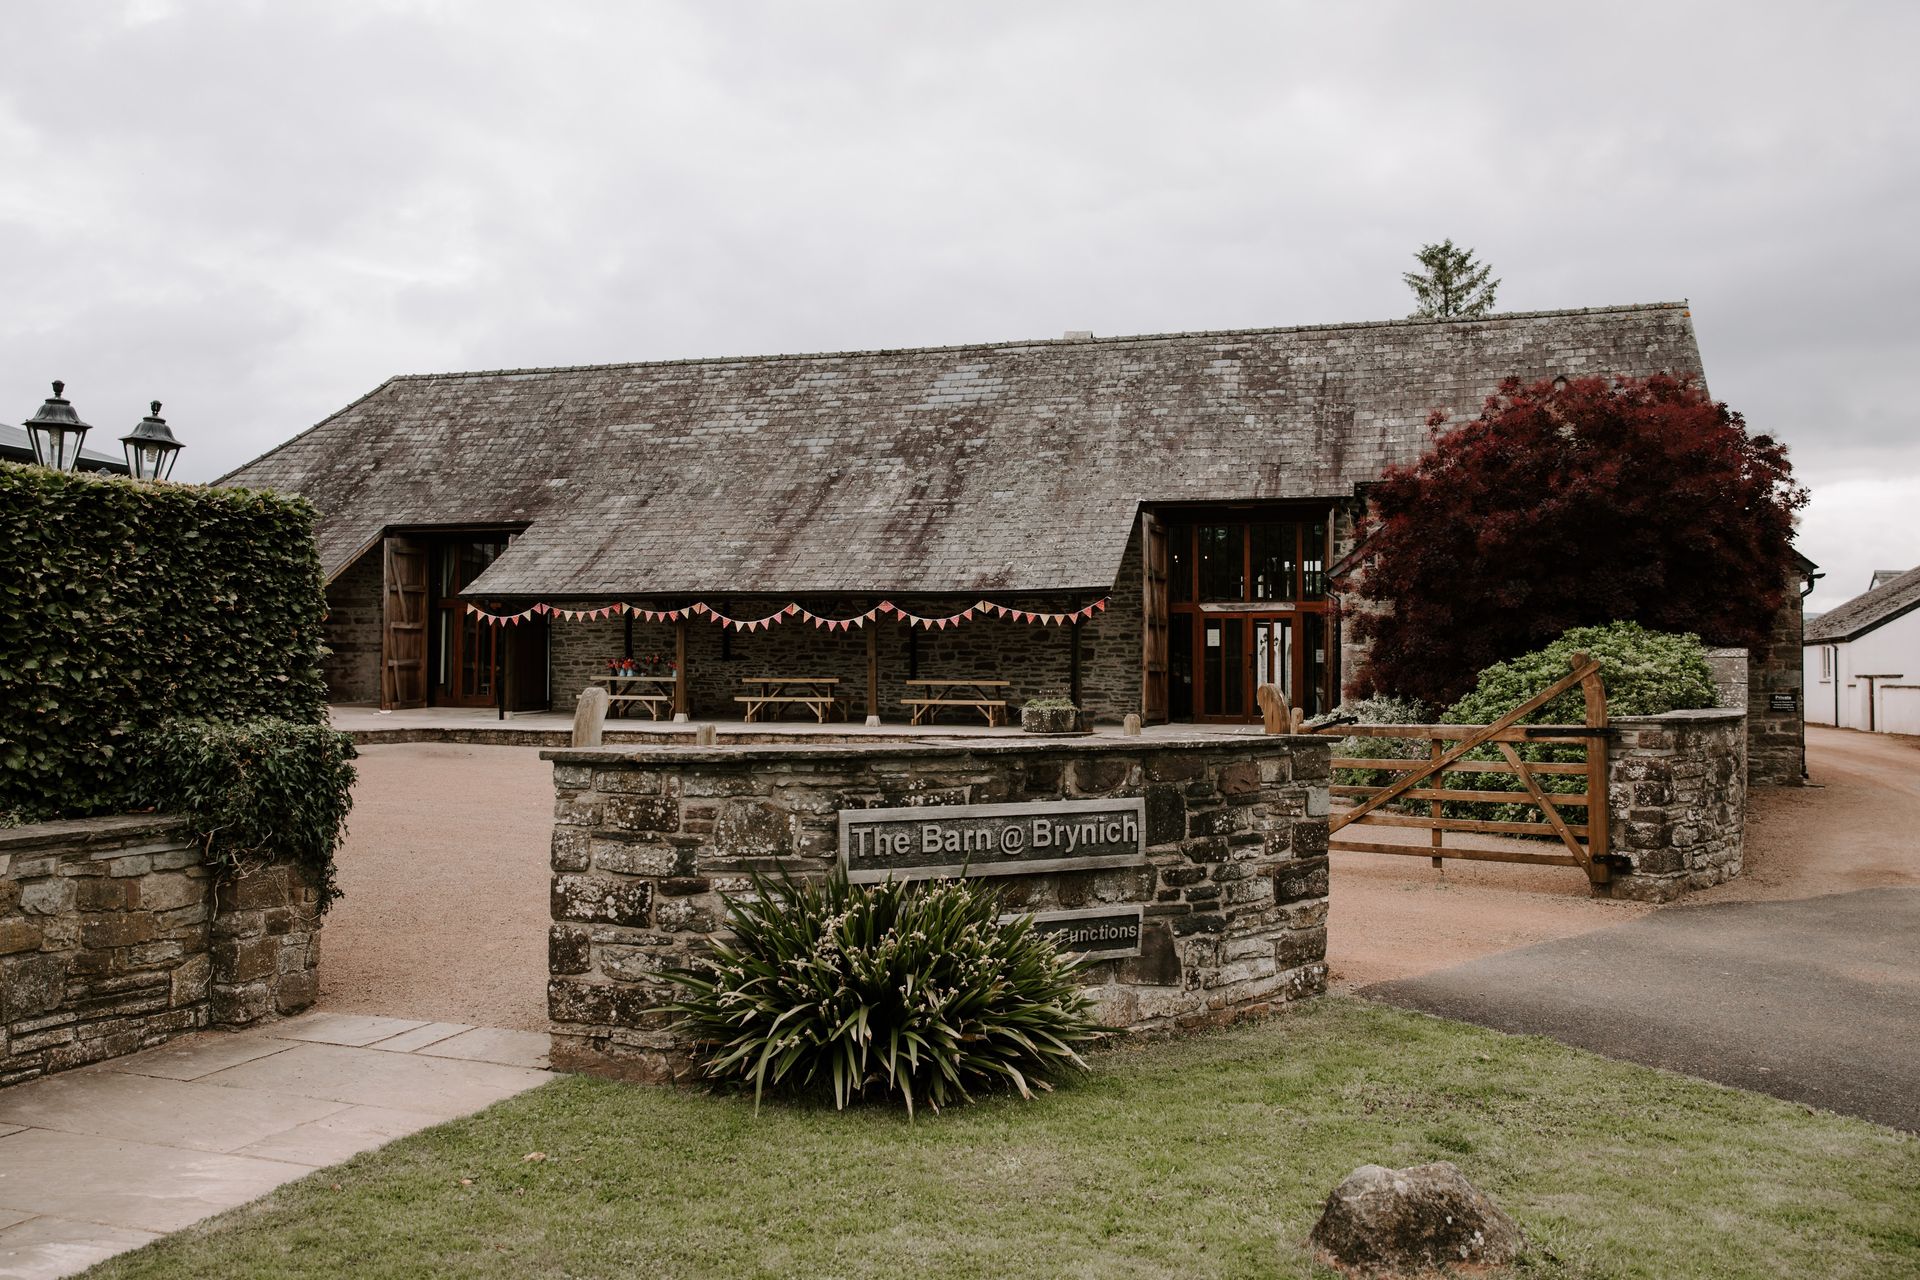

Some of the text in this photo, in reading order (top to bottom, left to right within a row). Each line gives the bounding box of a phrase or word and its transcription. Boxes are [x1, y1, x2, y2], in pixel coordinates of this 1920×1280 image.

[851, 815, 1138, 857] The Barn @ Brynich
[1059, 924, 1137, 943] Functions
